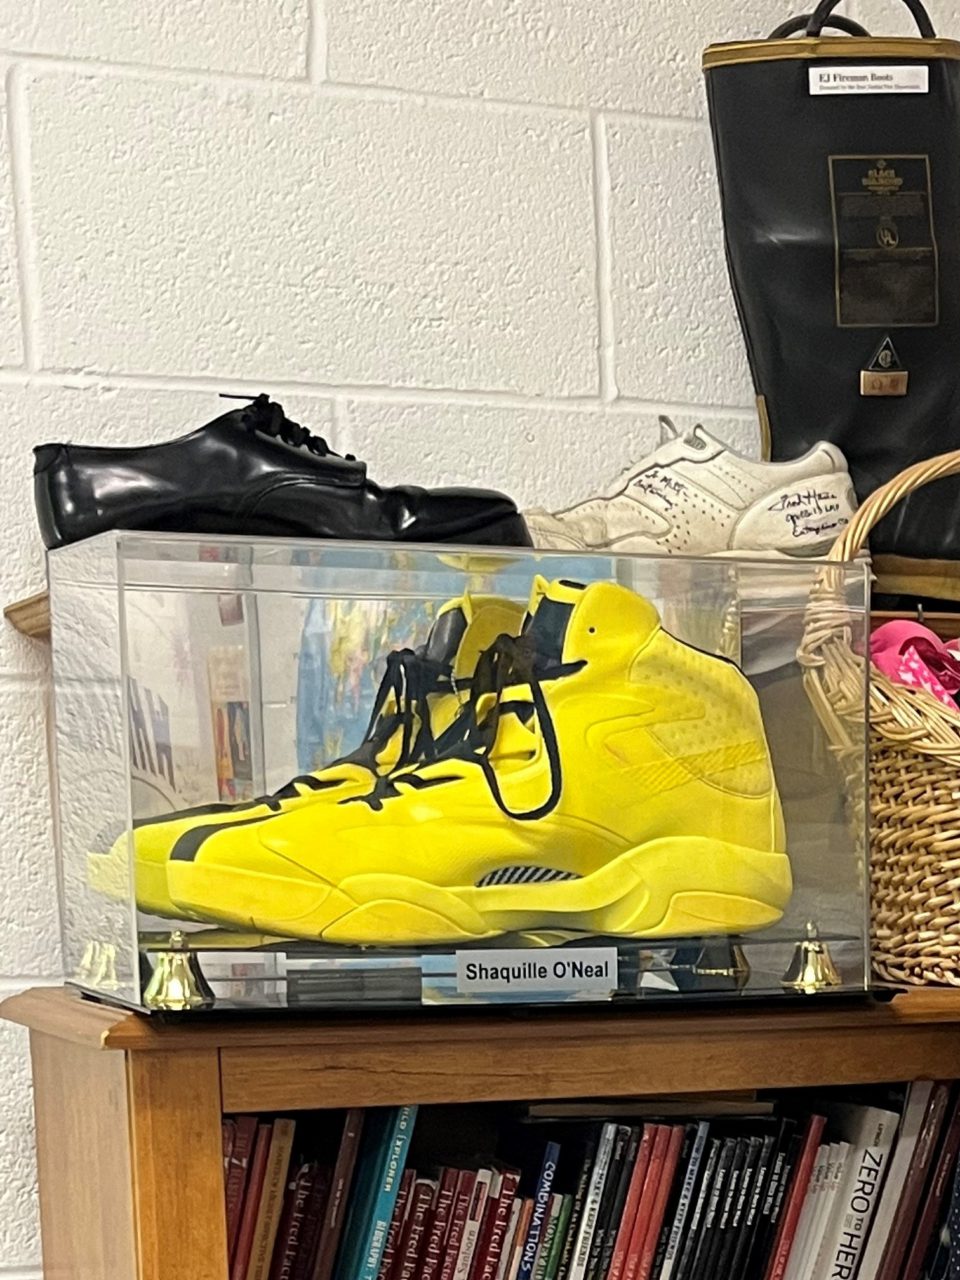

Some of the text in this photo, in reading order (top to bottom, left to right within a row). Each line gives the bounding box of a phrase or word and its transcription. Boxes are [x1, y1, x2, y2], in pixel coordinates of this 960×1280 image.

[466, 961, 609, 983] Shaquille O'Neal
[850, 1148, 884, 1214] ZERO
[413, 1192, 432, 1221] The
[434, 1189, 453, 1216] The
[454, 1194, 469, 1216] The
[497, 1188, 515, 1217] The
[521, 1161, 557, 1272] COMBINATIONS
[428, 1221, 446, 1253] Fred
[449, 1220, 465, 1247] Fred
[489, 1221, 507, 1253] Fred
[855, 1216, 865, 1231] TO
[406, 1225, 425, 1258] Fred
[458, 1229, 477, 1276] Sanborn
